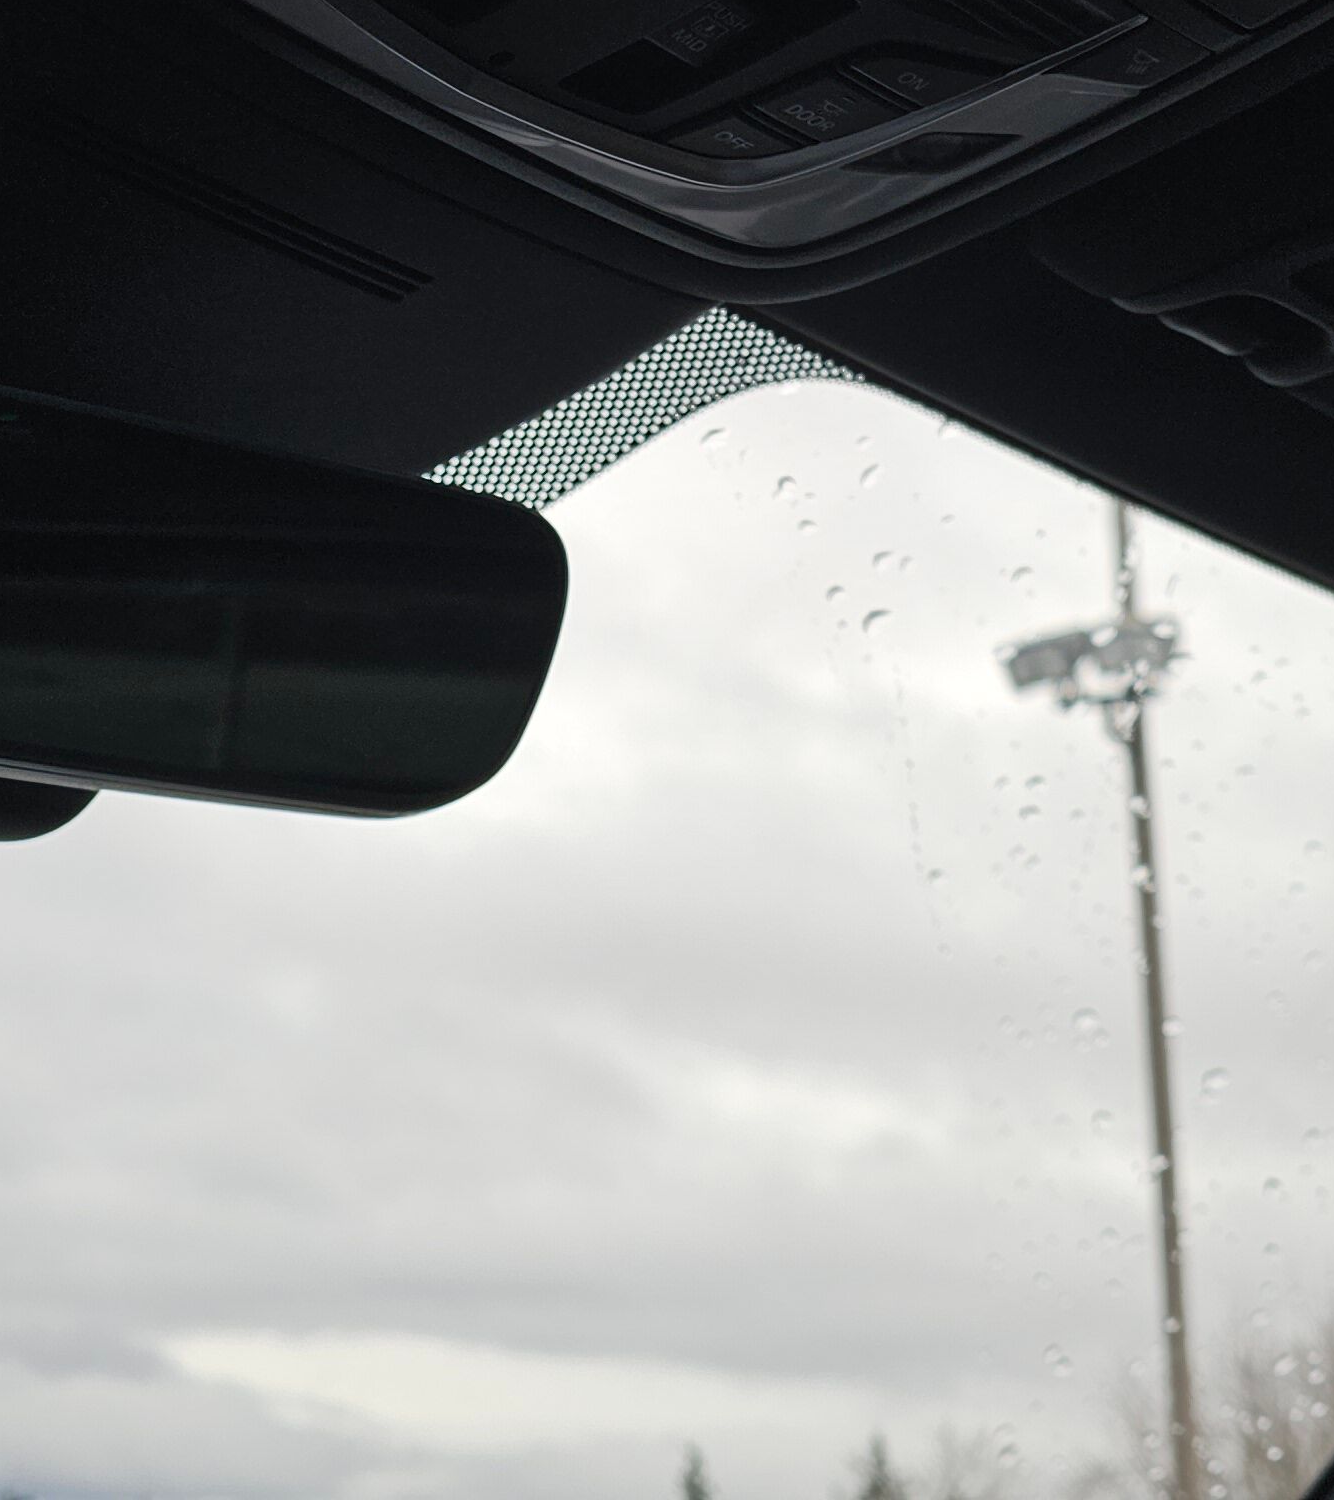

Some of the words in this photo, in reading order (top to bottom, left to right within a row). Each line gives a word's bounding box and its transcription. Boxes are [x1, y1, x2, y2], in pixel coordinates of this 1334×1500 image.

[703, 0, 747, 32] PUSH
[671, 28, 707, 52] MID
[898, 72, 931, 92] ON
[785, 103, 835, 132] DOOR
[714, 131, 754, 150] OFF
